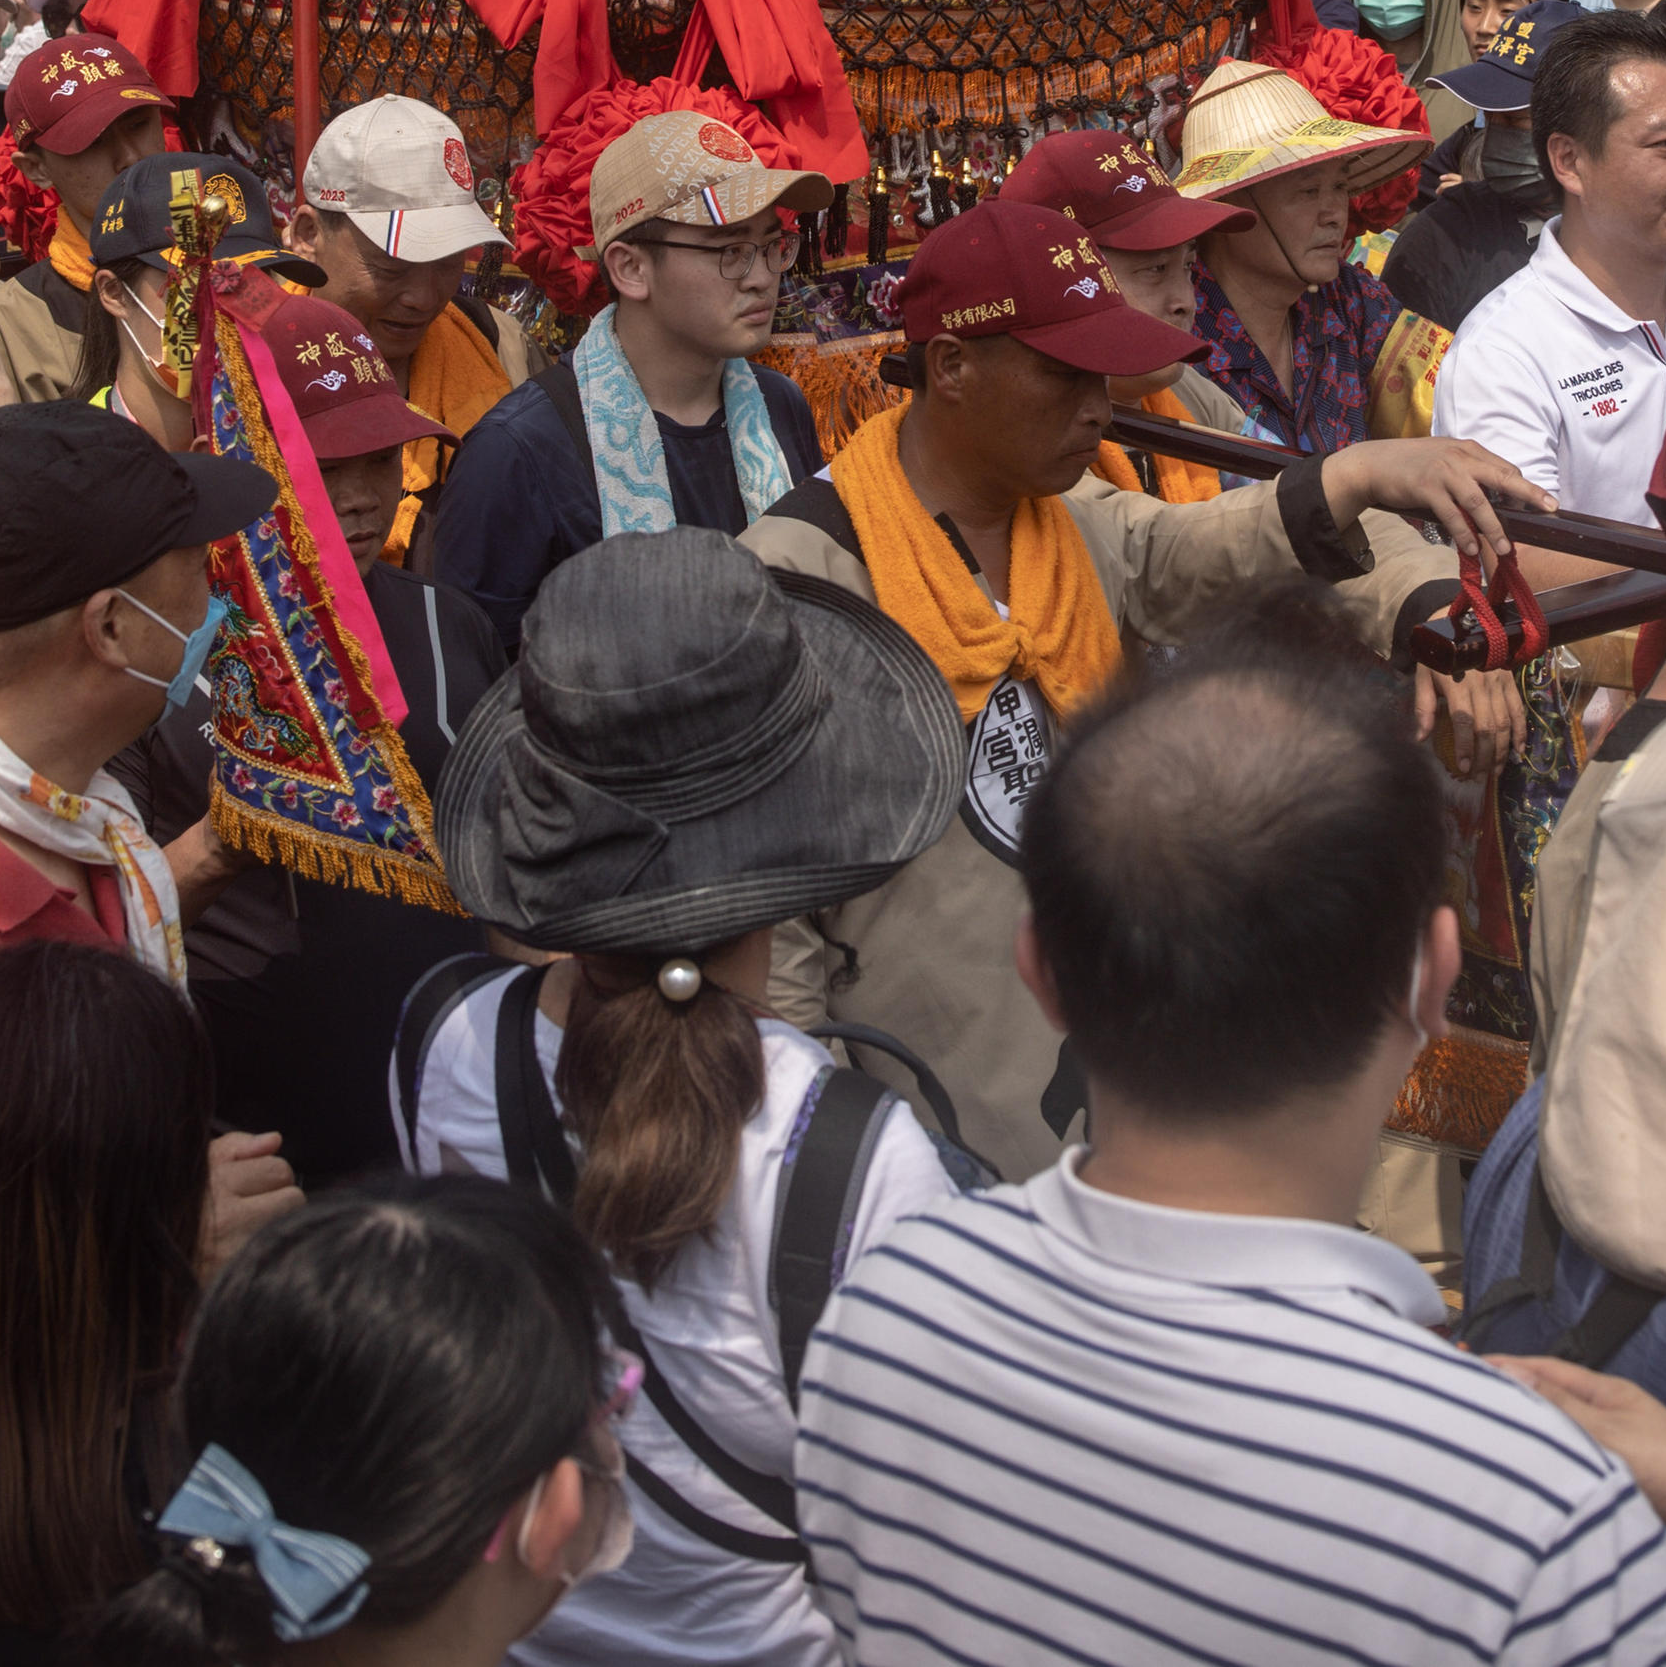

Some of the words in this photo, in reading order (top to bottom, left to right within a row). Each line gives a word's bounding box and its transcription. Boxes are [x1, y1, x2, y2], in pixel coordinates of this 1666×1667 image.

[319, 189, 346, 202] 2023
[615, 198, 645, 225] 2022
[1558, 378, 1571, 390] LA
[1570, 367, 1605, 387] MARQUE
[1604, 361, 1624, 375] DES
[1572, 380, 1623, 403] TRICOLORES
[1591, 399, 1620, 418] 1882
